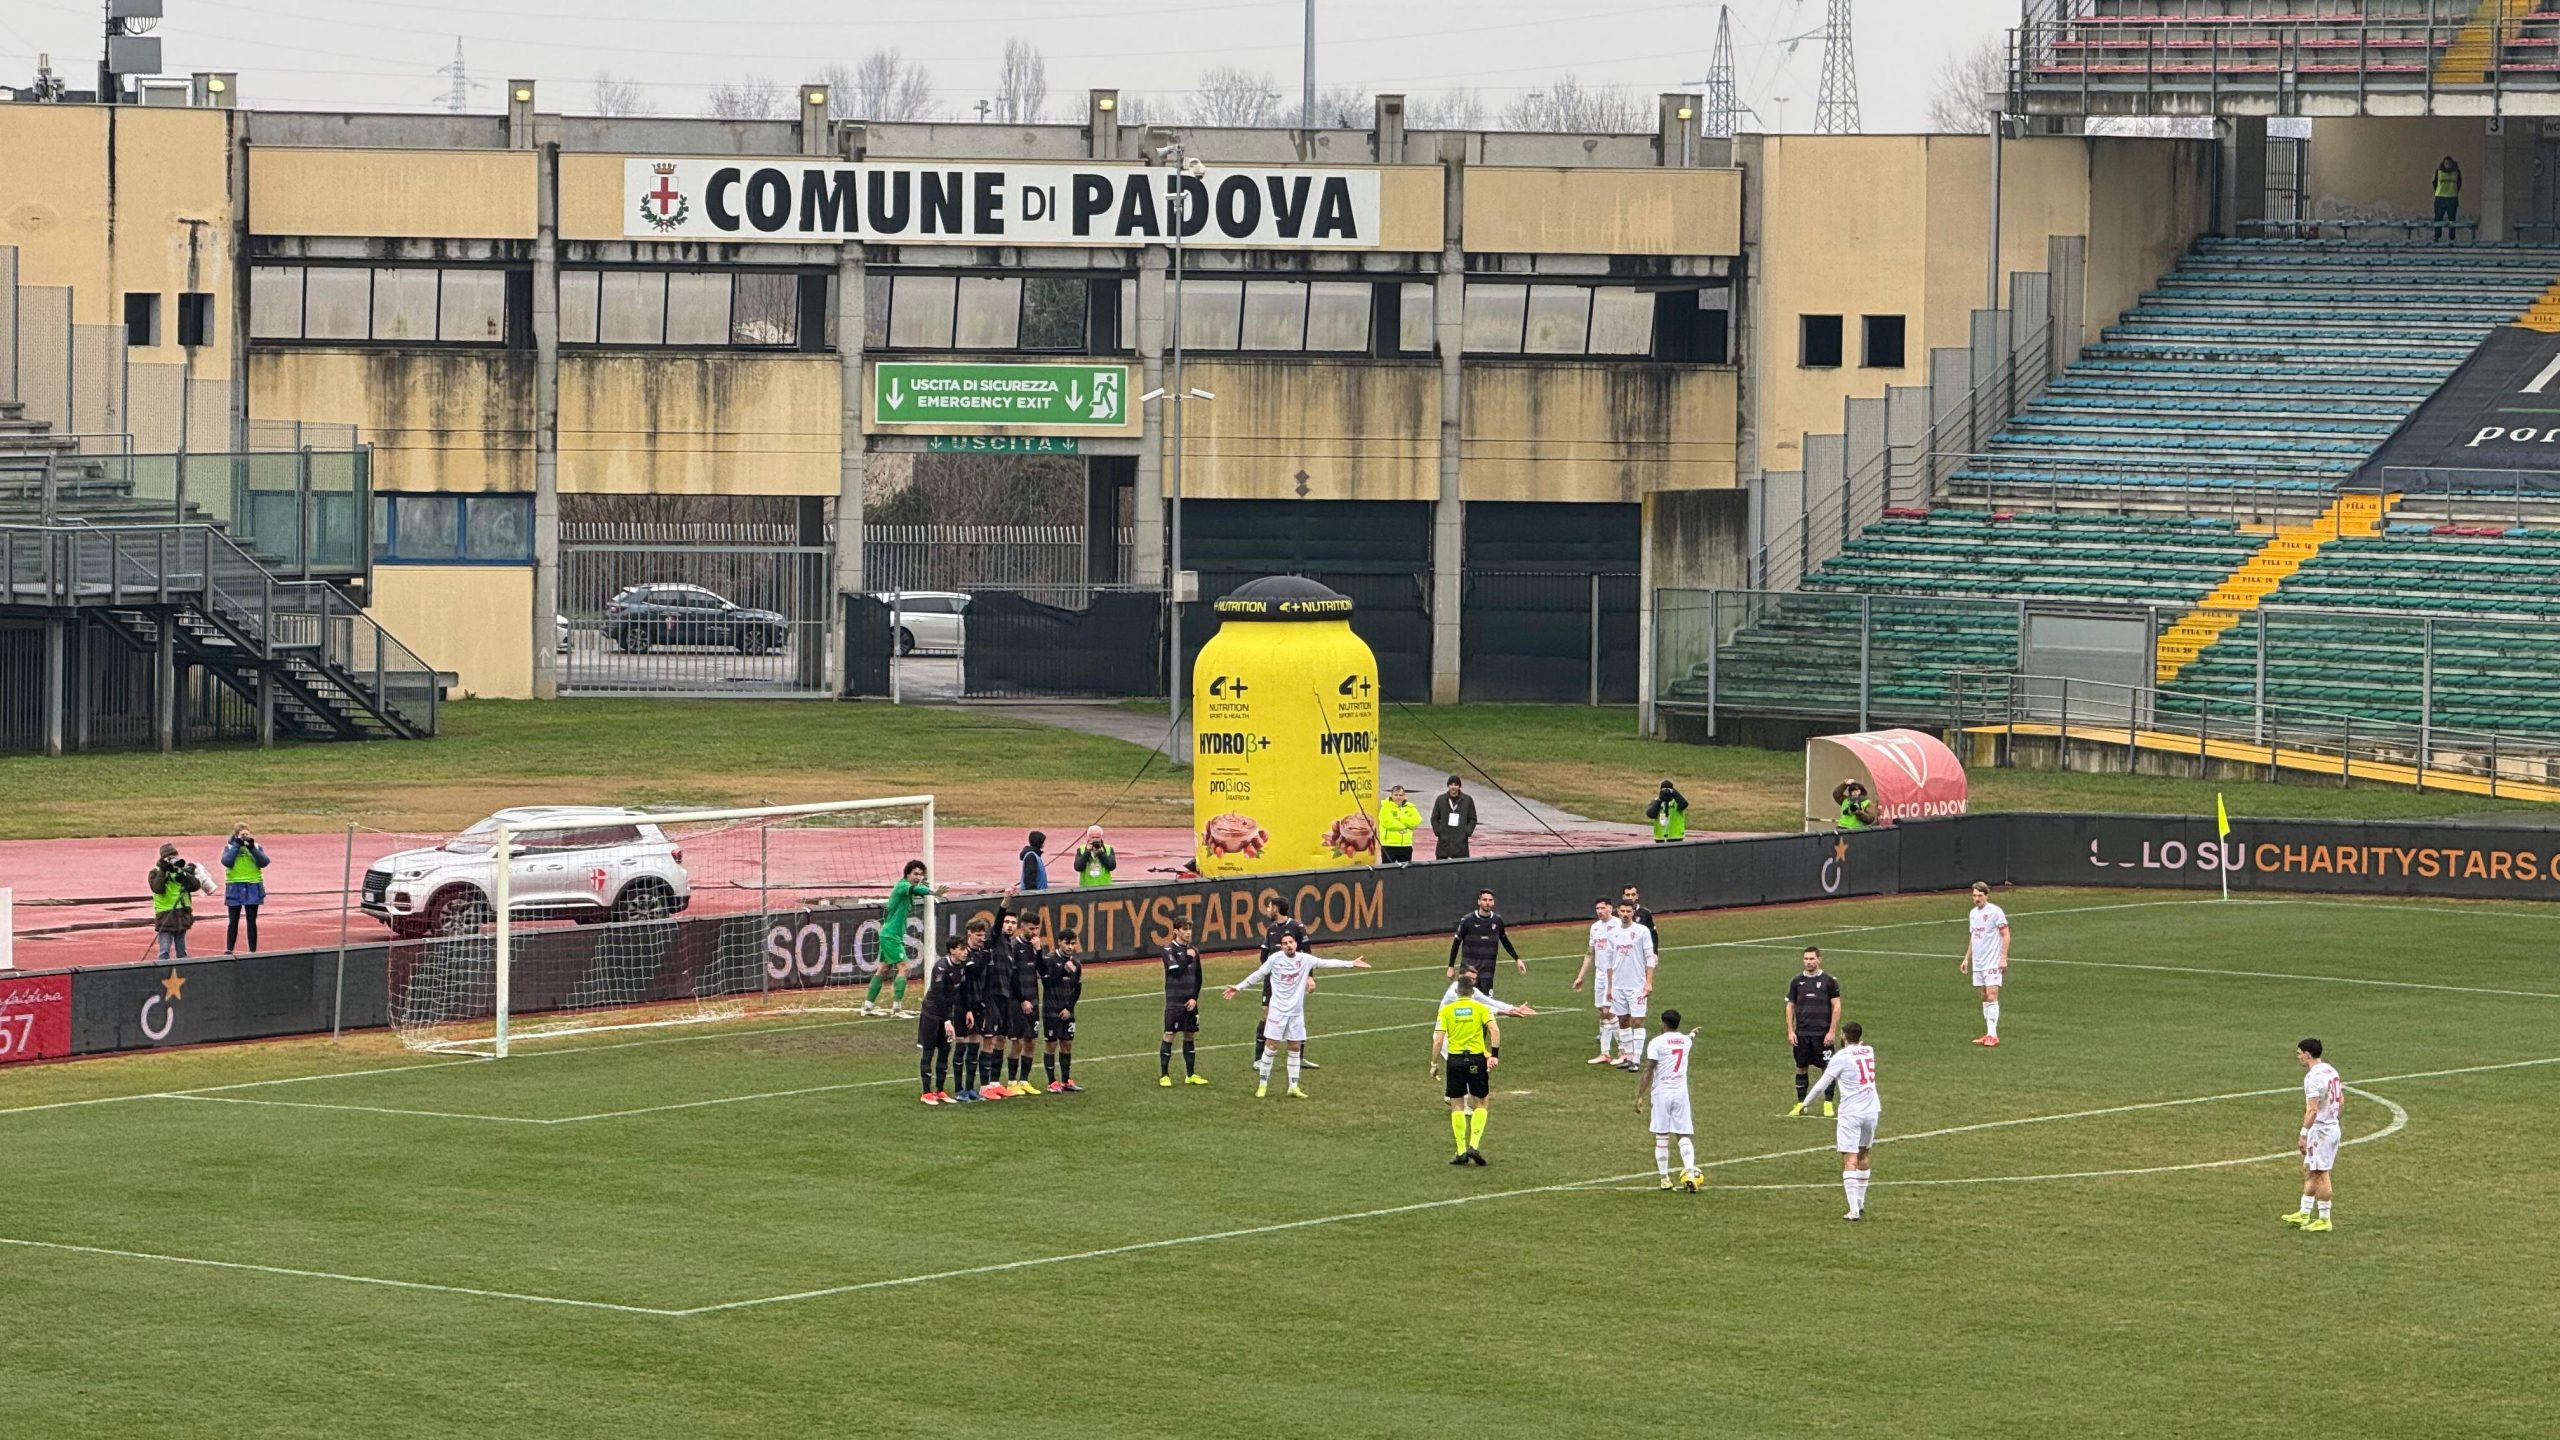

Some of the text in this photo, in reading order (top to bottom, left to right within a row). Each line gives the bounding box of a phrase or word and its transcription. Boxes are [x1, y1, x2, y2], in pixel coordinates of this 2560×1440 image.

[2490, 116, 2499, 132] 3
[705, 167, 1358, 239] COMUNE DI PADOVA
[910, 379, 1059, 393] USCITA DI SICUREZZA
[917, 396, 1052, 409] EMERGENCY EXIT
[951, 436, 1053, 451] USCITA
[1209, 675, 1249, 700] 4+
[1209, 703, 1249, 711] NUTRITION
[2196, 841, 2245, 871] SU
[767, 918, 893, 979] SOLO
[1671, 1049, 1684, 1072] 7
[1822, 1050, 1832, 1061] 32
[1856, 1058, 1876, 1085] 15
